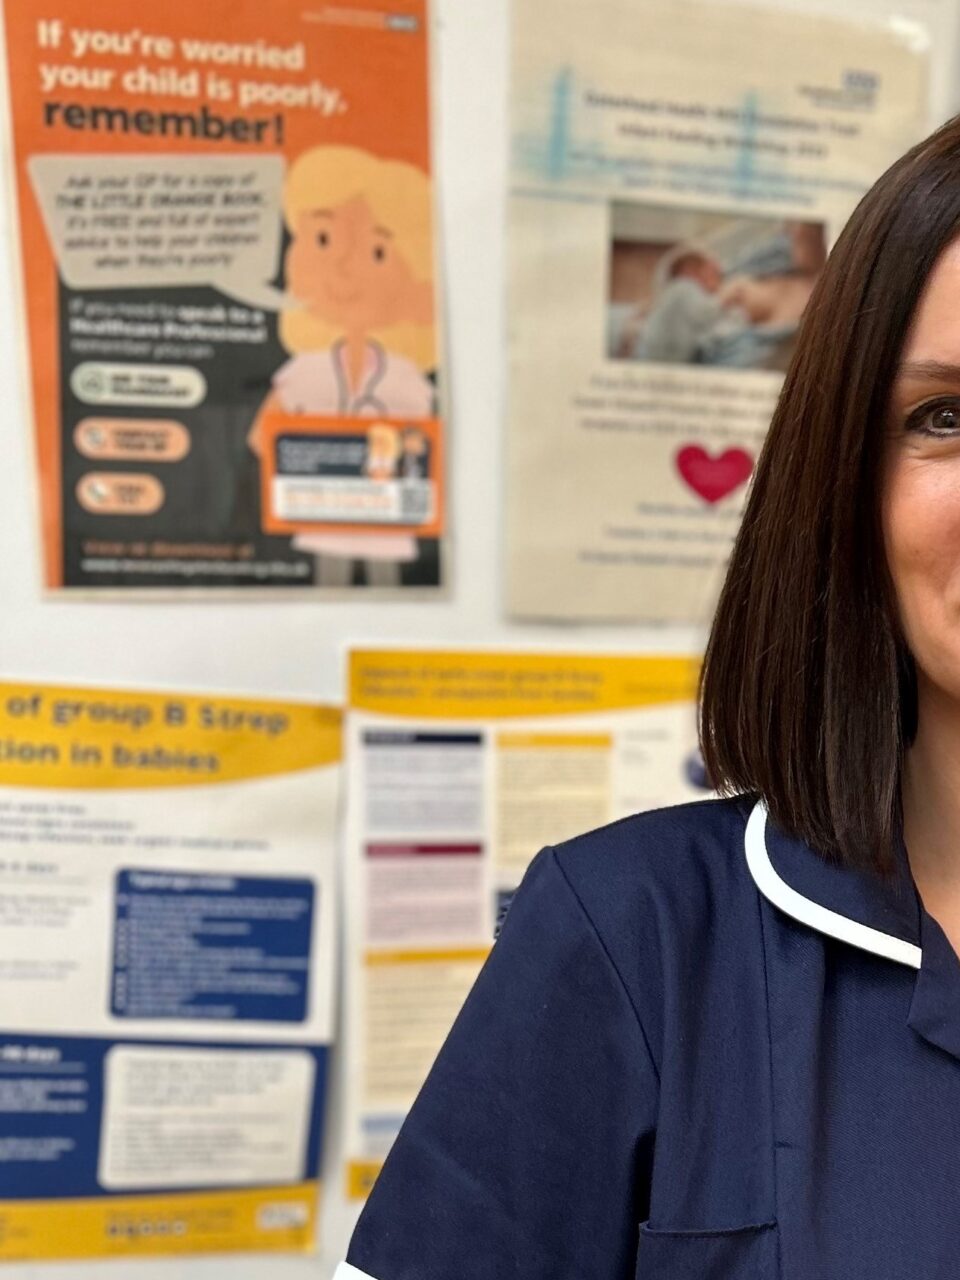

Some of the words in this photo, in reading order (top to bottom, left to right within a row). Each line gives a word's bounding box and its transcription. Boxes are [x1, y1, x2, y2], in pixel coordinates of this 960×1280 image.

[37, 20, 63, 47] If
[70, 28, 174, 58] you're
[180, 36, 305, 70] worried
[39, 62, 114, 92] your
[122, 65, 199, 97] child
[207, 71, 233, 101] is
[43, 100, 285, 146] remember!
[6, 694, 42, 717] of
[52, 700, 153, 731] group
[165, 703, 187, 728] B
[201, 703, 290, 736] Strep
[70, 743, 102, 766] in
[111, 743, 221, 774] babies
